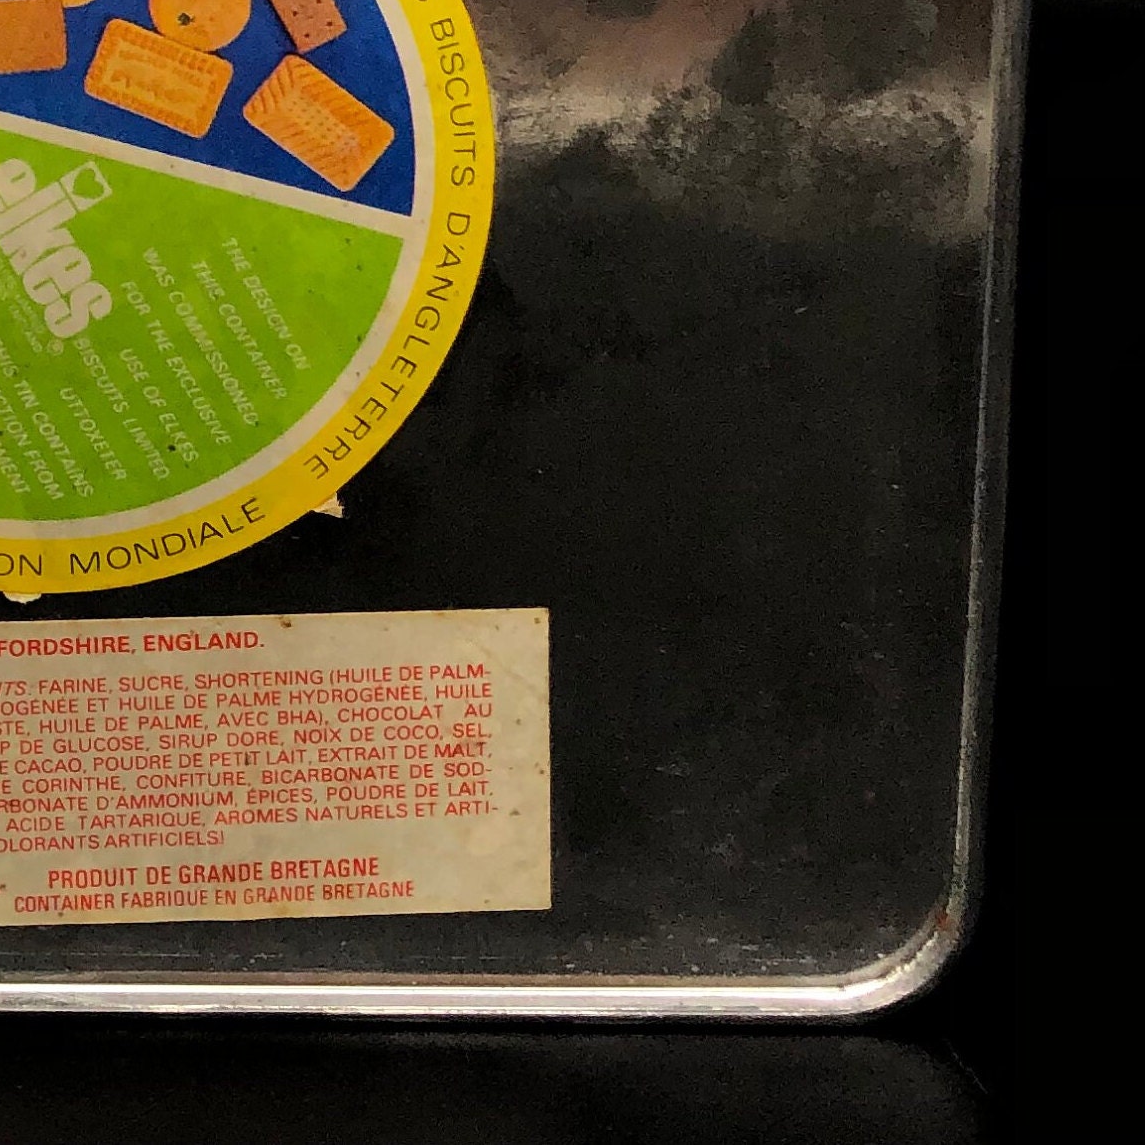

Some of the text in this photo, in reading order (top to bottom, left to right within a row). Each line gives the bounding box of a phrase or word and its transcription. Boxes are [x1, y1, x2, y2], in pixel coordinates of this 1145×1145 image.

[430, 17, 476, 187] BISCUITS
[222, 237, 311, 370] THE DESIGN ON
[143, 247, 259, 427] WAS COMMISSIONED
[192, 260, 287, 399] THIS CONTAINER
[303, 212, 471, 480] D'ANGLETERRE
[120, 280, 232, 446] FOR THE EXCLUSIVE
[73, 337, 170, 482] BISCUITS LIMITED
[119, 349, 199, 463] USE OF ELKES
[14, 380, 41, 409] TIN
[32, 411, 94, 498] CONTAINS
[59, 388, 127, 481] UTTOXETER
[25, 450, 65, 500] FROM
[69, 496, 267, 575] MONDIALE
[142, 631, 265, 652] ENGLAND.
[118, 695, 174, 711] HUILE
[216, 689, 281, 708] PALME
[435, 682, 495, 700] HUILE
[194, 669, 324, 690] SHORTENING
[329, 666, 392, 684] (HUILE
[429, 663, 492, 680] PALM-
[39, 718, 96, 733] HUILE
[218, 711, 268, 727] AVEC
[337, 703, 443, 723] CHOCOLAT
[464, 702, 493, 718] AU
[159, 733, 216, 750] SIRUP
[293, 727, 341, 745] NOIX
[93, 751, 172, 771] POUDRE
[318, 744, 398, 764] EXTRAIT
[262, 764, 398, 785] BICARBONATE
[6, 814, 65, 832] ACIDE
[214, 806, 298, 826] AROMES
[305, 803, 408, 823] NATURELS
[444, 800, 498, 819] ARTI-
[326, 783, 406, 803] POUDRE
[13, 881, 415, 912] CONTAINER EN GRANDE BRETAGNE
[47, 857, 380, 889] PRODUIT DE GRANDE BRETAGNE
